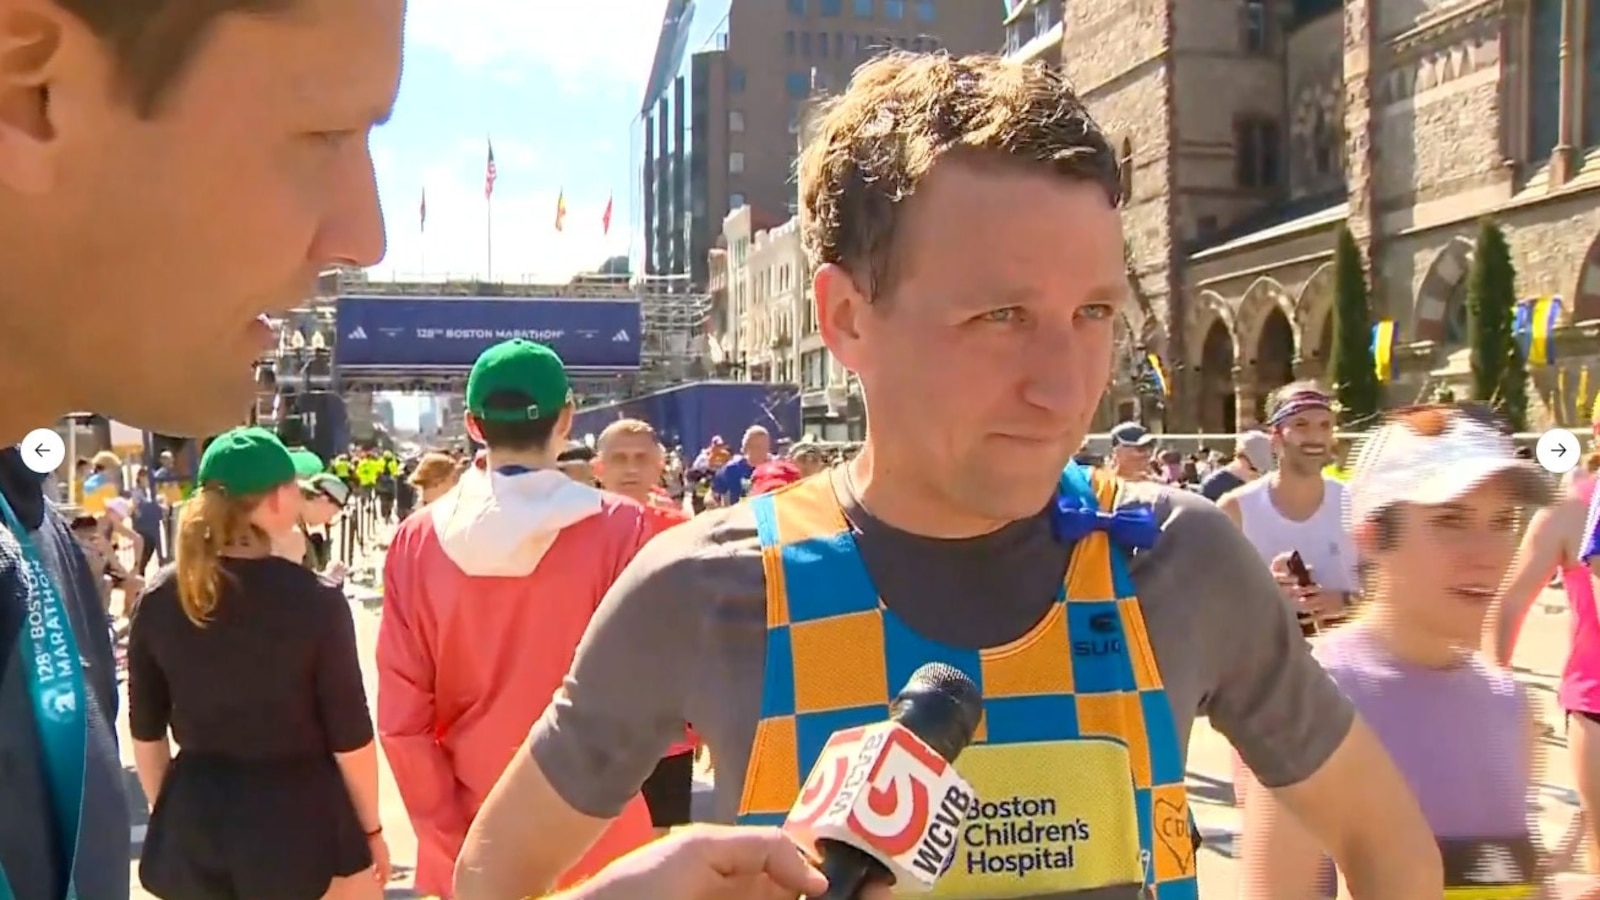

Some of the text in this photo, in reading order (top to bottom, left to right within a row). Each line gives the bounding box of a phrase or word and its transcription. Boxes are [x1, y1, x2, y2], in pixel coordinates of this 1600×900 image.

[446, 328, 493, 339] BOSTON
[32, 559, 73, 677] MARATHON
[966, 796, 1056, 820] Boston
[913, 785, 971, 875] WCVB
[964, 818, 1089, 847] Children's
[966, 845, 1074, 877] Hospital
